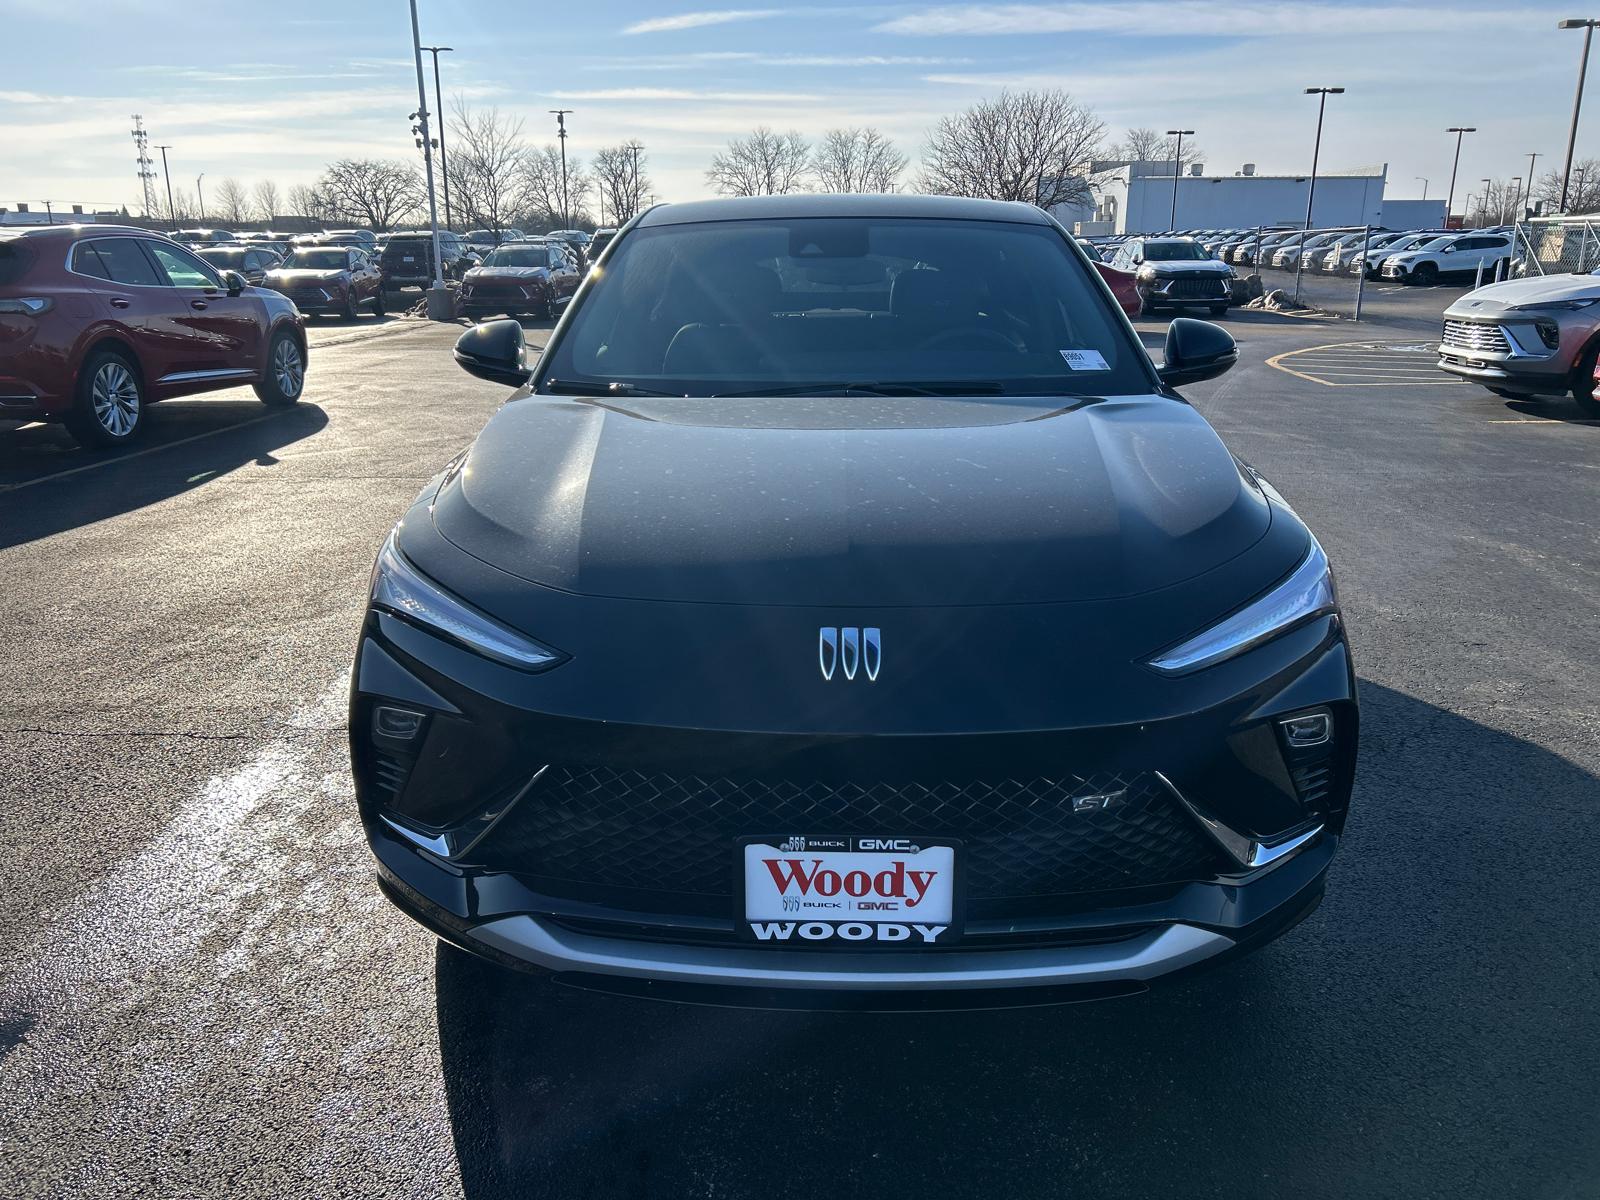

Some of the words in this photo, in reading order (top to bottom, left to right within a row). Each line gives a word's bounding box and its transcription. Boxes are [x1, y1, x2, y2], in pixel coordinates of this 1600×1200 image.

[859, 839, 910, 850] GMC
[762, 859, 938, 907] Woody
[857, 901, 899, 911] GMC
[750, 922, 948, 943] WOODY
